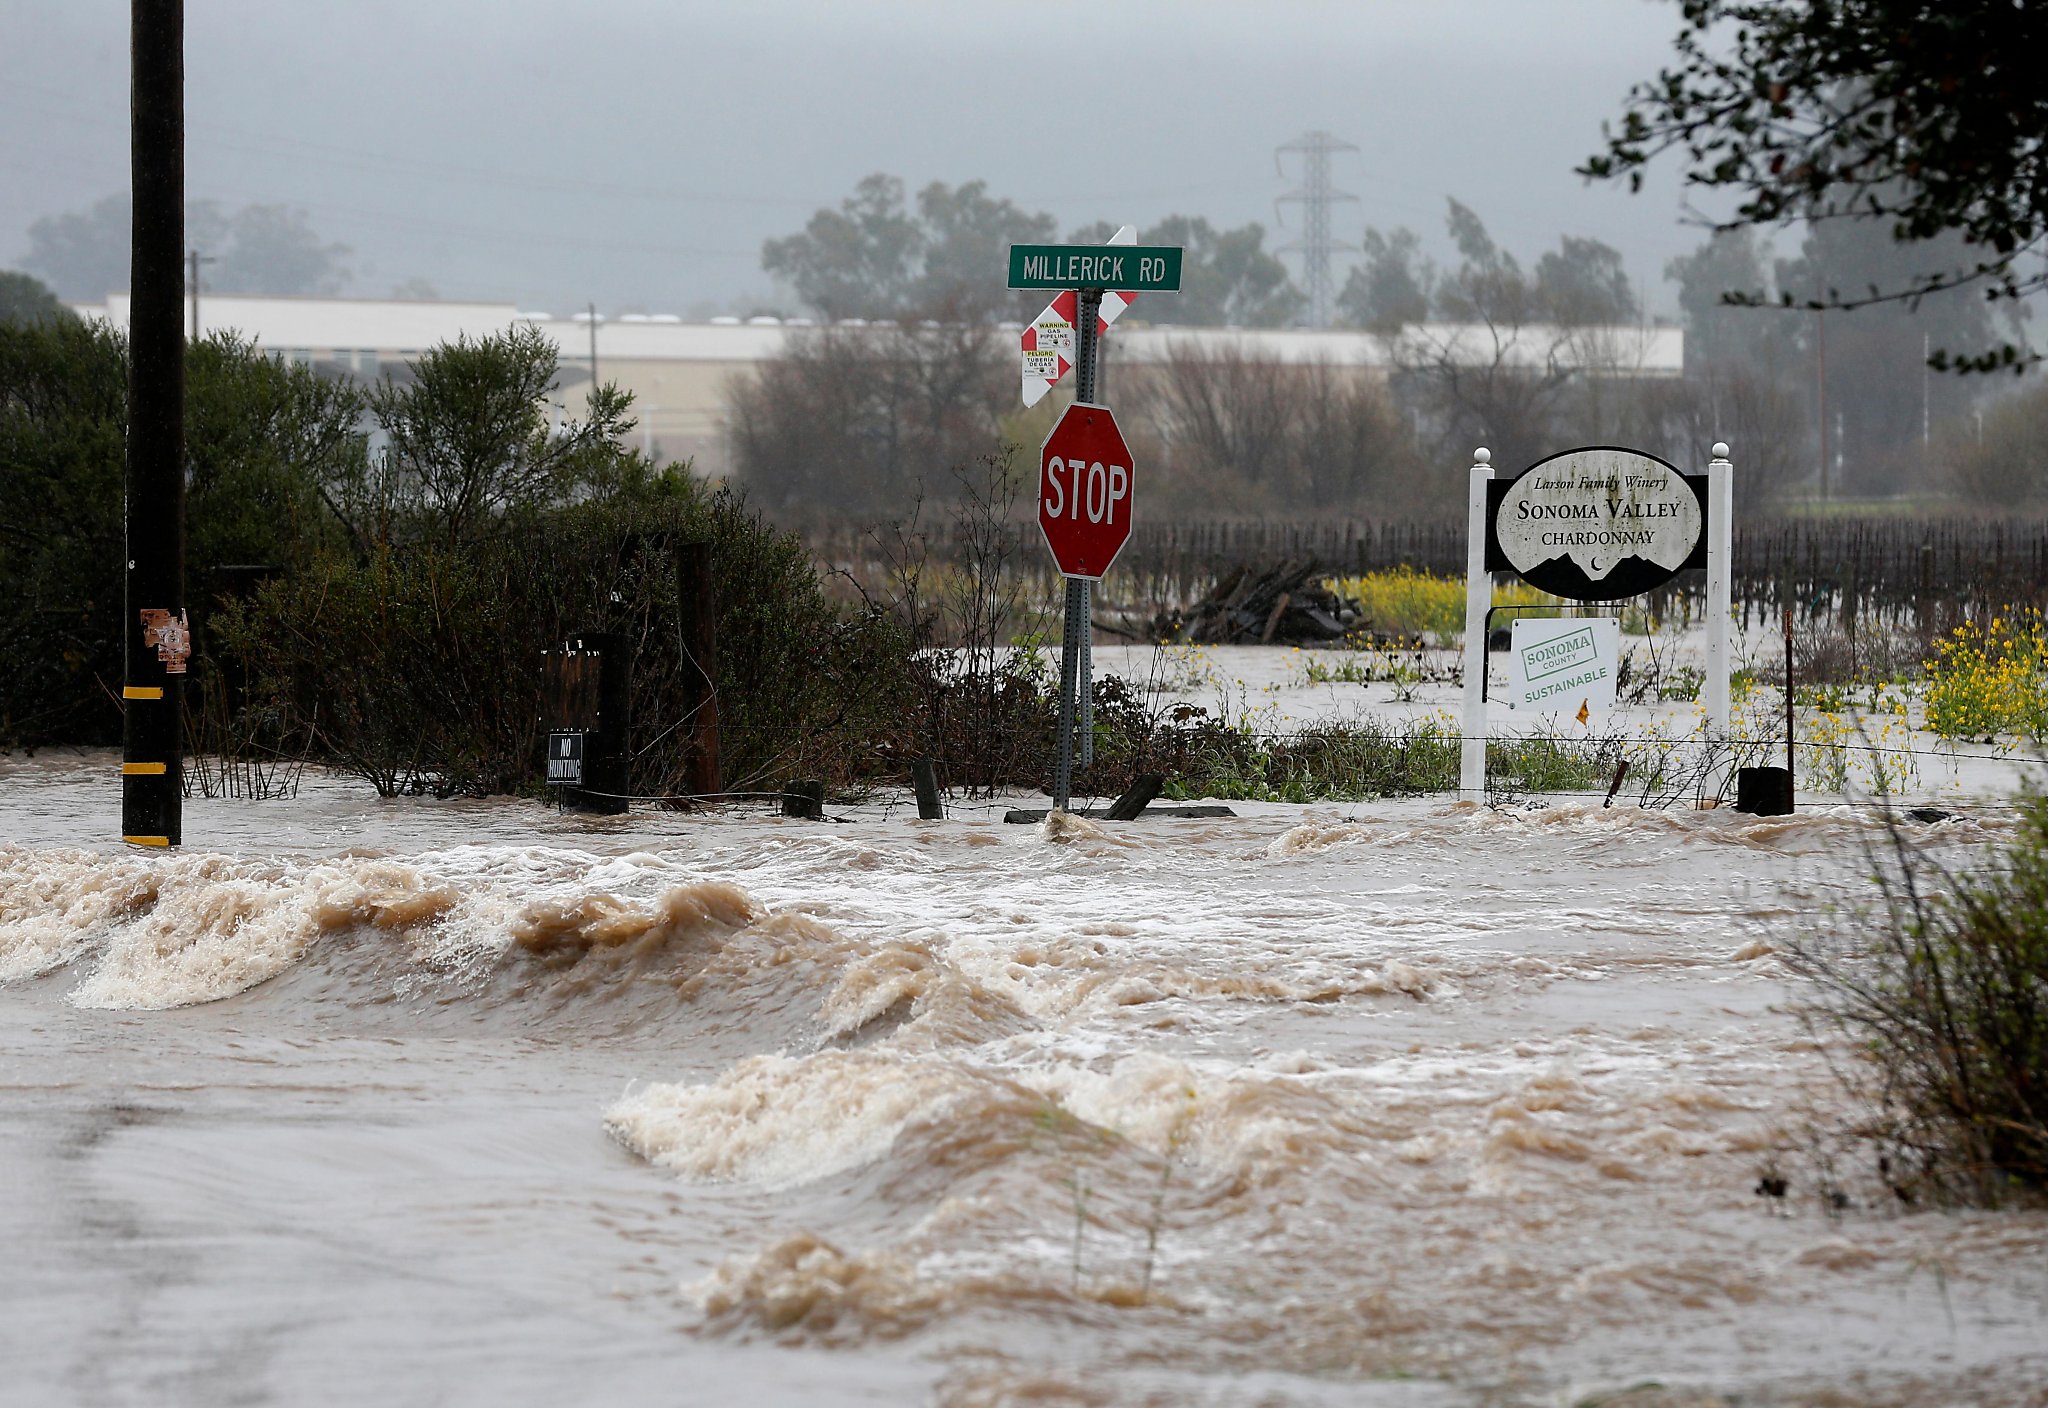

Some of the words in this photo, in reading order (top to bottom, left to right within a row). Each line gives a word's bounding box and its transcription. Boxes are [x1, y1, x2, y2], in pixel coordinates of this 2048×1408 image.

[1023, 255, 1124, 282] MILLERICK
[1139, 256, 1166, 282] RD
[1045, 455, 1128, 525] STOP
[1534, 477, 1574, 490] Larson
[1578, 476, 1620, 491] Family
[1624, 475, 1668, 491] Winery
[1517, 500, 1599, 520] SONOMA
[1606, 498, 1681, 519] VALLEY
[1541, 531, 1656, 546] CHARDONNAY
[1527, 635, 1591, 665] SONOMA
[1542, 653, 1577, 670] COUNTY
[1525, 667, 1608, 703] SUSTAINABLE
[560, 738, 571, 757] NO
[549, 759, 580, 778] HUNTING
